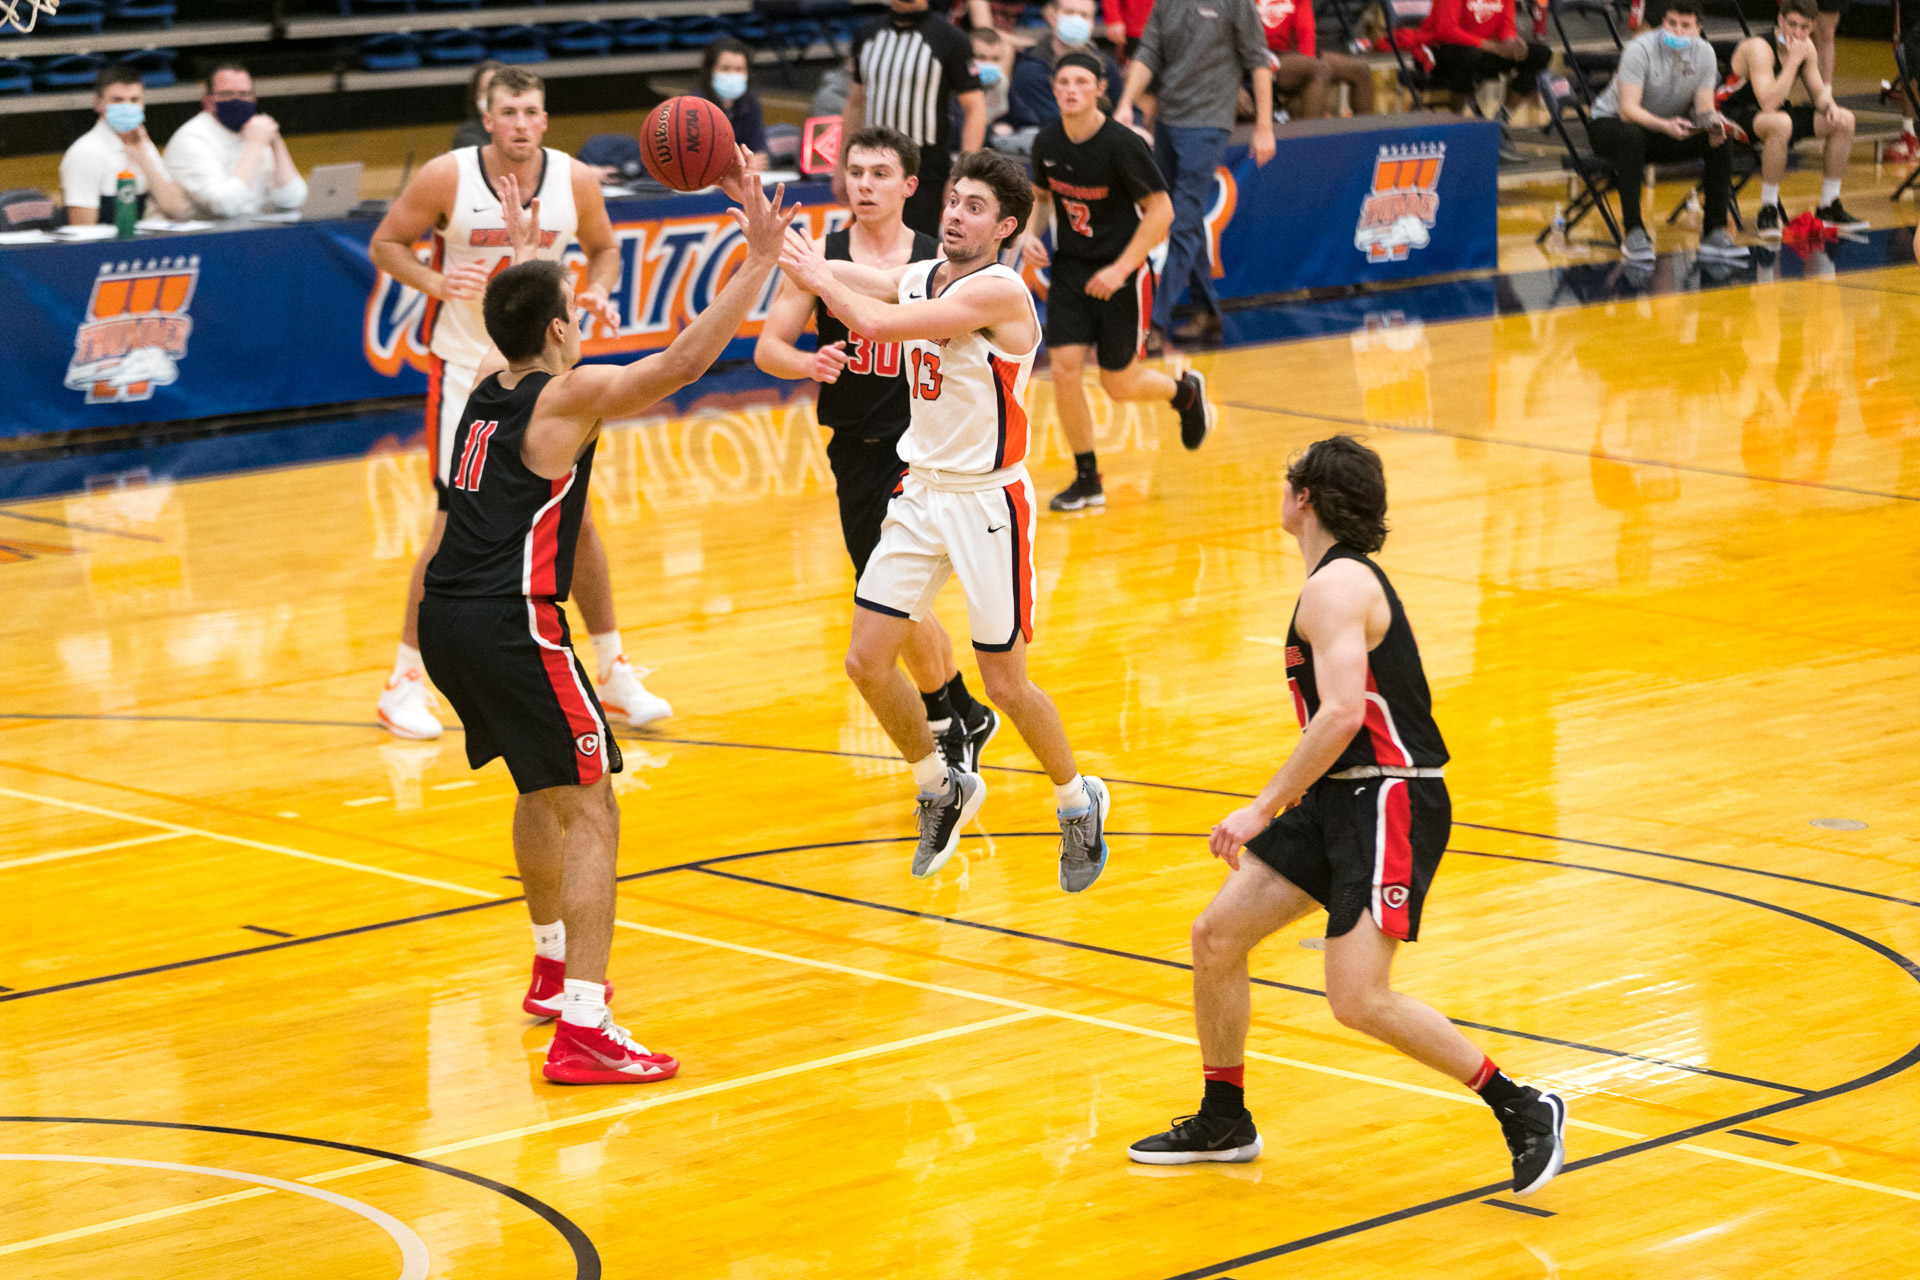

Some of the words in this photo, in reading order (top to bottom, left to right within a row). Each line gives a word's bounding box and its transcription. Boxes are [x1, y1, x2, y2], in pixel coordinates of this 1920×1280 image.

[654, 103, 675, 165] Wilson
[686, 109, 700, 153] NCAA
[848, 330, 902, 378] 30
[911, 347, 943, 401] 13
[454, 419, 499, 492] 11
[582, 736, 595, 753] C
[1388, 887, 1403, 905] C
